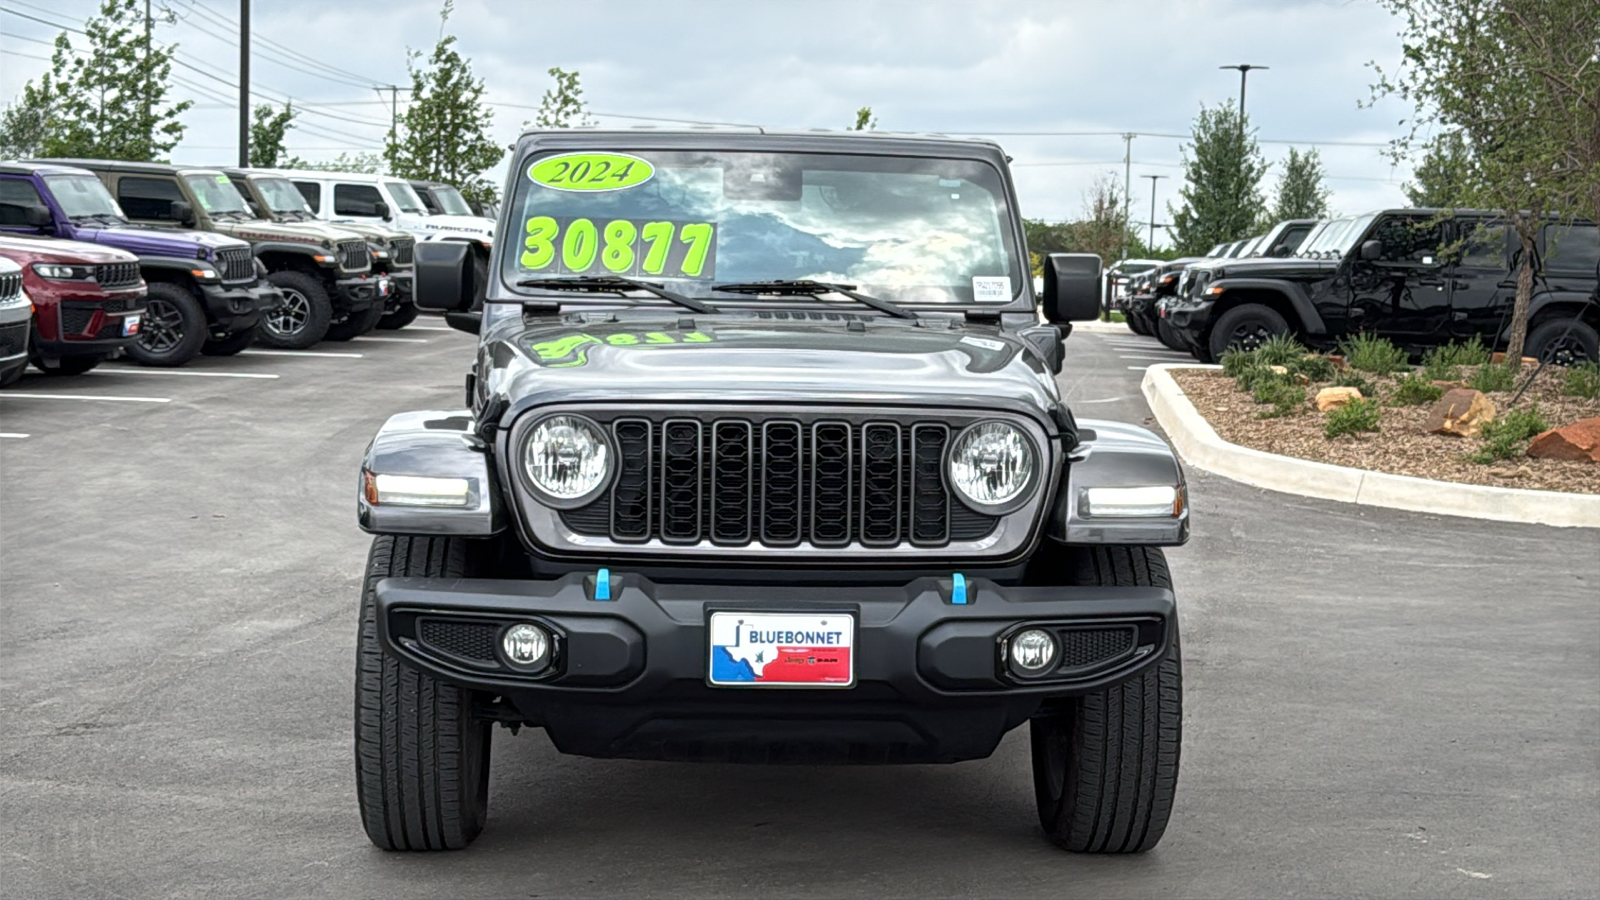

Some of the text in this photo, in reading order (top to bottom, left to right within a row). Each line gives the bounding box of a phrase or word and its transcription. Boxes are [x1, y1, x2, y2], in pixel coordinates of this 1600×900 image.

[547, 160, 635, 183] 2024
[425, 224, 484, 233] RUBICON
[520, 215, 714, 276] 30877
[749, 631, 842, 645] BLUEBONNET
